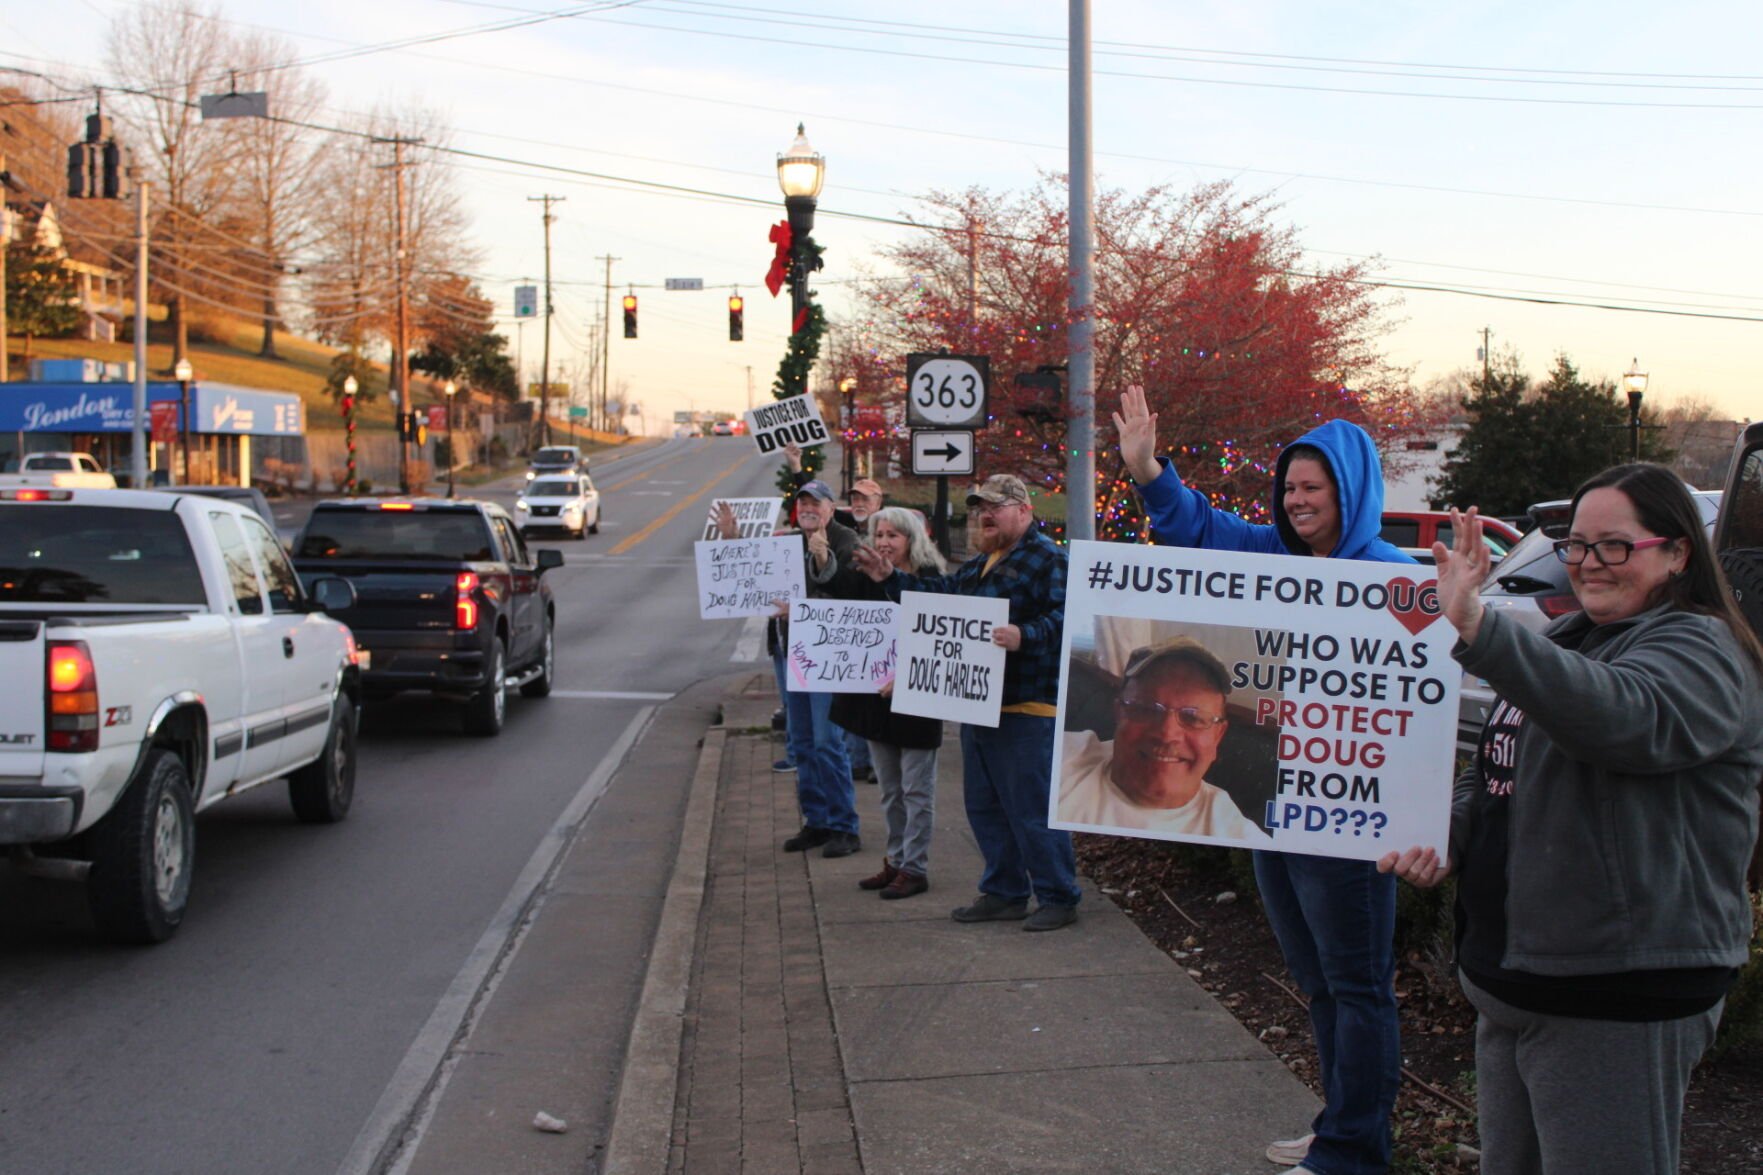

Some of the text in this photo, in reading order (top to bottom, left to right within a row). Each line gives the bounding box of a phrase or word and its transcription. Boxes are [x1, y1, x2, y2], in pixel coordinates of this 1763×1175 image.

[918, 373, 976, 408] 363
[23, 393, 118, 431] London
[753, 398, 810, 429] JUSTICE FOR
[756, 419, 826, 453] DOUG
[751, 501, 770, 519] FOR
[705, 522, 772, 540] DUG
[711, 561, 774, 582] JUSTICE
[735, 578, 757, 592] FOR
[706, 592, 738, 610] DOUG
[1089, 561, 1441, 615] #JUSTICE FOR DOUG
[794, 604, 893, 625] DOUG HARLESS
[912, 613, 993, 643] JUSTICE
[812, 625, 885, 648] DESERVED
[934, 640, 963, 660] FOR
[1254, 630, 1429, 669] WHO WAS
[834, 651, 849, 662] TO
[908, 656, 991, 702] DOUG HARLESS
[1232, 662, 1446, 705] SUPPOSE TO
[1256, 698, 1414, 736] PROTECT
[1278, 734, 1386, 769] DOUG
[1277, 768, 1380, 803] FROM
[1265, 801, 1388, 838] LPD???
